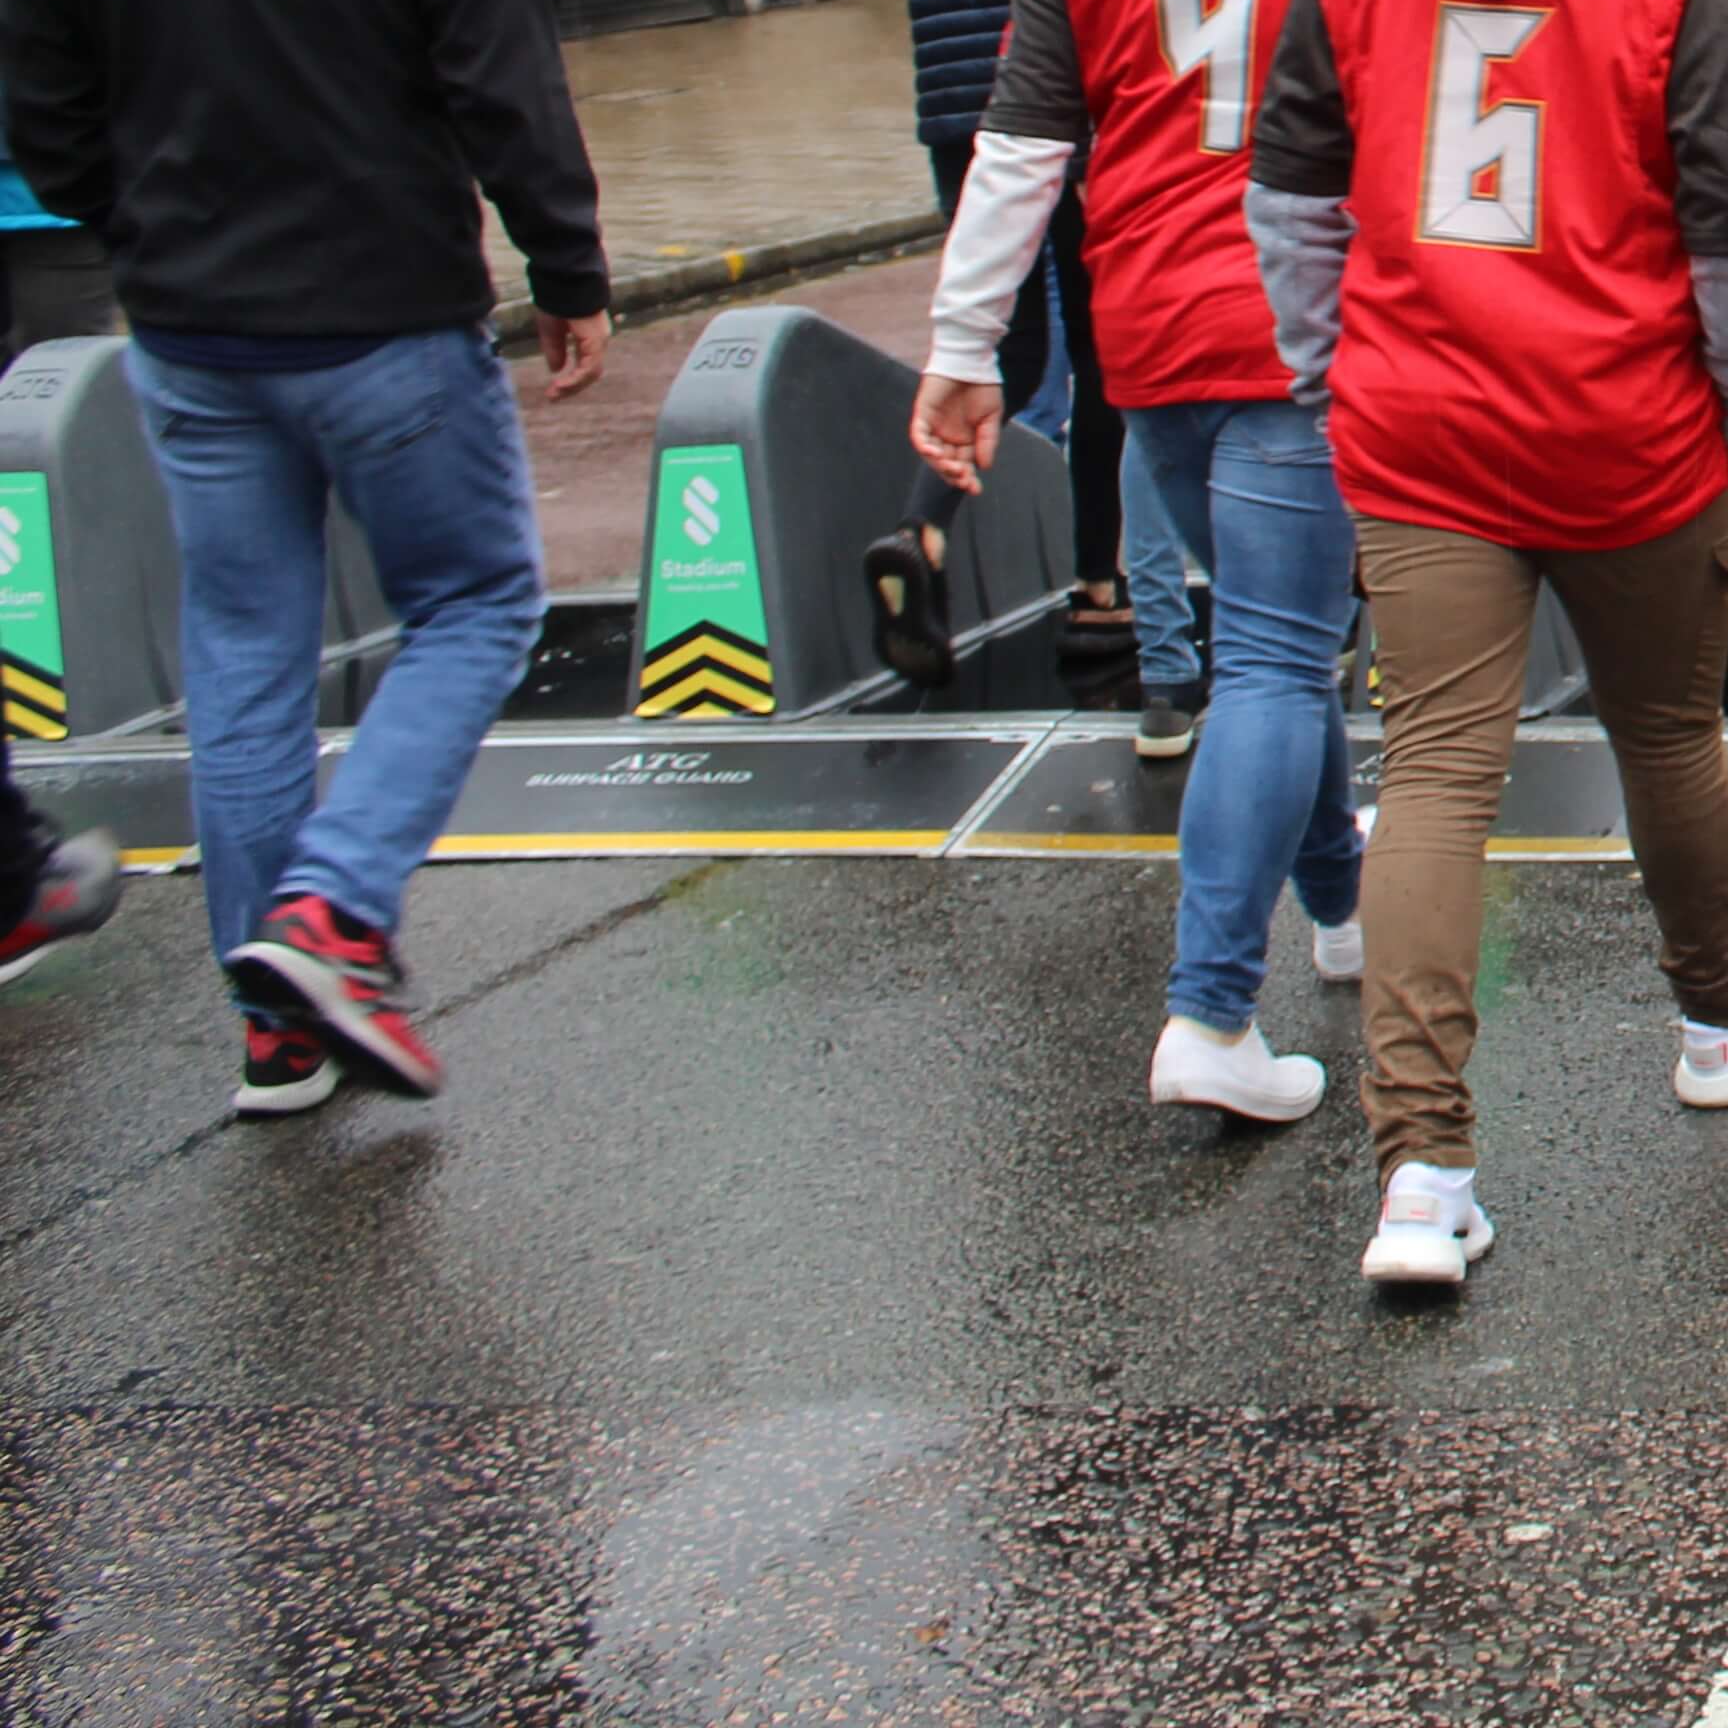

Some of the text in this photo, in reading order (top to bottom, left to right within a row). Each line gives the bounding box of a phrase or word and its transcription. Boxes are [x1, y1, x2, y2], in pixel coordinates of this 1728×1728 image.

[1414, 0, 1556, 254] 6
[694, 344, 758, 371] ATG
[661, 557, 746, 578] Stadium
[605, 752, 713, 771] ATG
[525, 771, 754, 787] SURFACE GUARD
